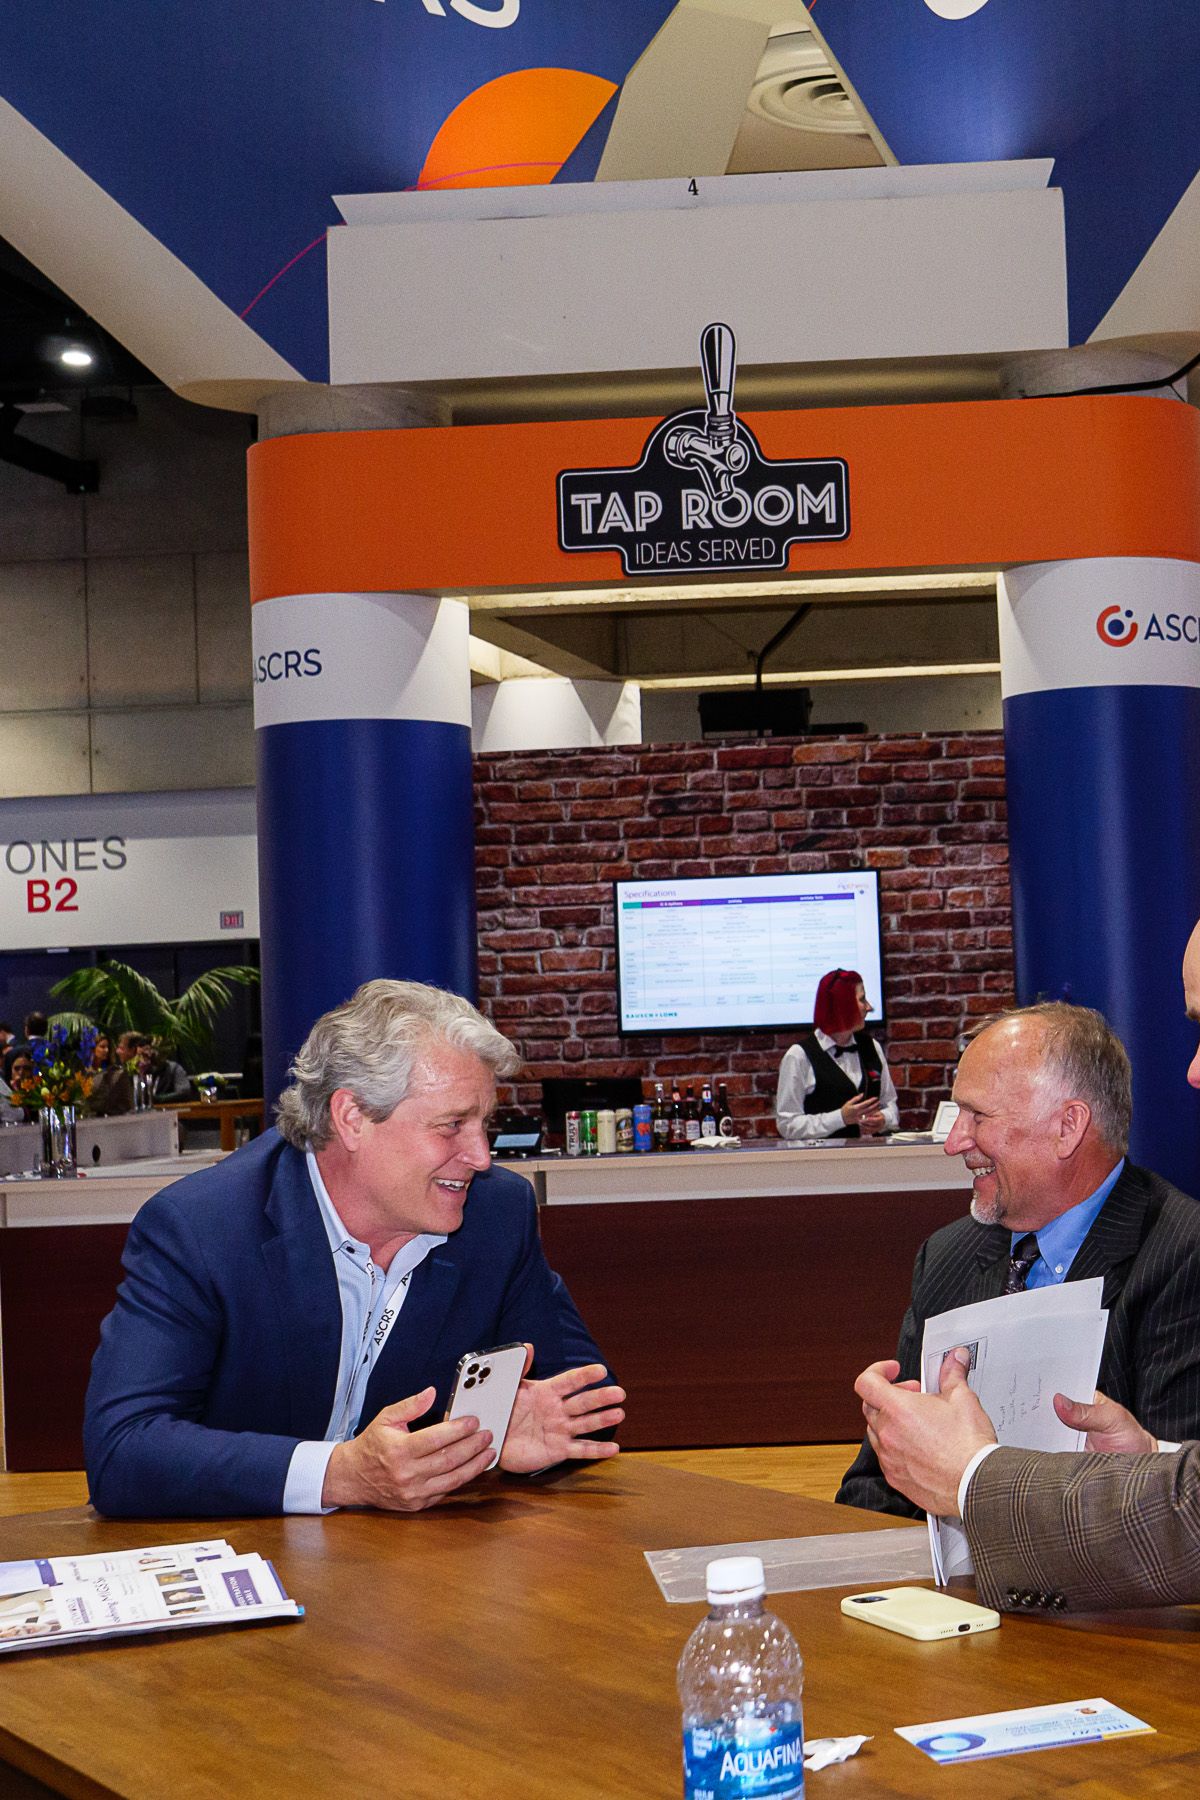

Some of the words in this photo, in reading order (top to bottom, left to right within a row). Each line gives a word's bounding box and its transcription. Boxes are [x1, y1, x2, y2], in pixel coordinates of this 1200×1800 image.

[688, 178, 699, 196] 4
[570, 491, 663, 535] TAP
[681, 482, 837, 531] ROOM
[635, 540, 692, 565] IDEAS
[698, 537, 776, 562] SERVED
[5, 835, 127, 875] ONES
[27, 877, 79, 914] B2
[624, 889, 677, 899] Specifications
[568, 1121, 577, 1149] TRULY
[373, 1308, 395, 1346] ASCRS
[719, 1736, 803, 1781] AQUAFINA
